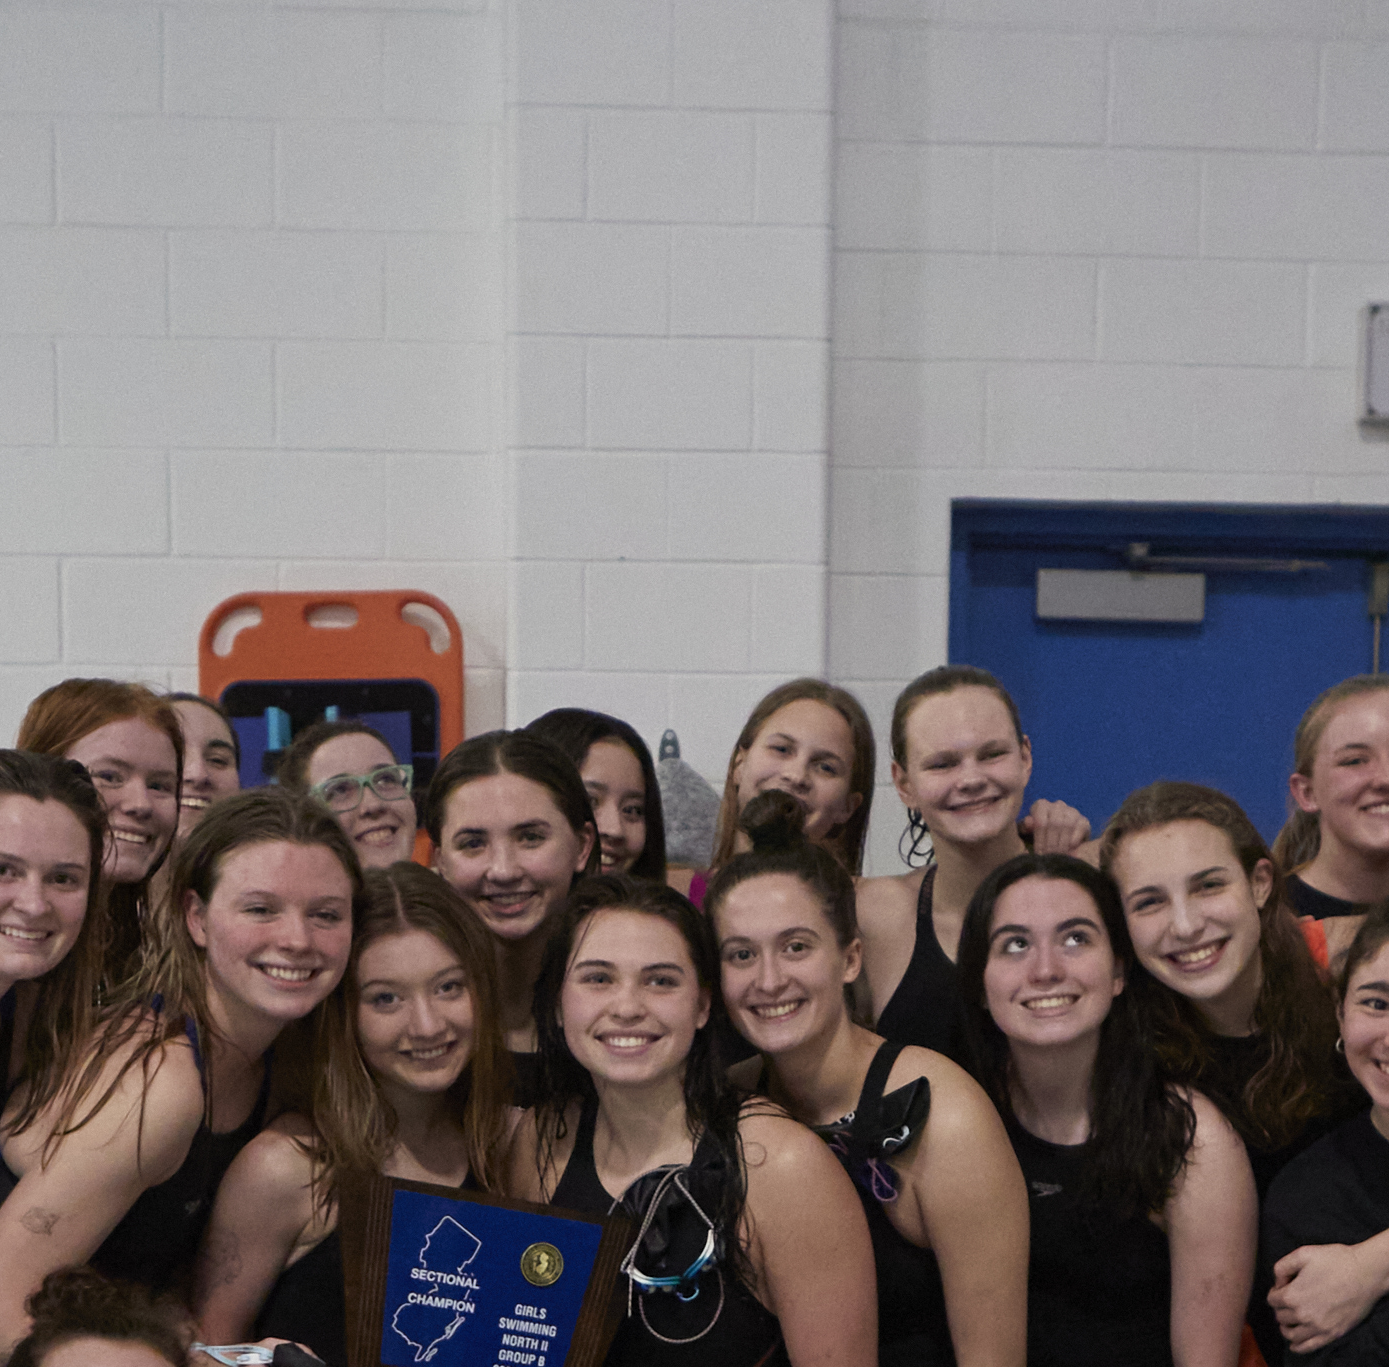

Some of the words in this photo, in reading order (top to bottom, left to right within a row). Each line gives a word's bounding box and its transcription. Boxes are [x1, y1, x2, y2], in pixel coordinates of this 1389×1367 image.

[410, 1268, 480, 1289] SECTIONAL
[407, 1292, 475, 1313] CHAMPION
[515, 1304, 547, 1319] GIRLS
[498, 1317, 557, 1337] SWIMMING
[502, 1334, 539, 1351] NORTH
[540, 1341, 549, 1352] II
[498, 1349, 536, 1365] GROUP
[537, 1356, 546, 1367] B
